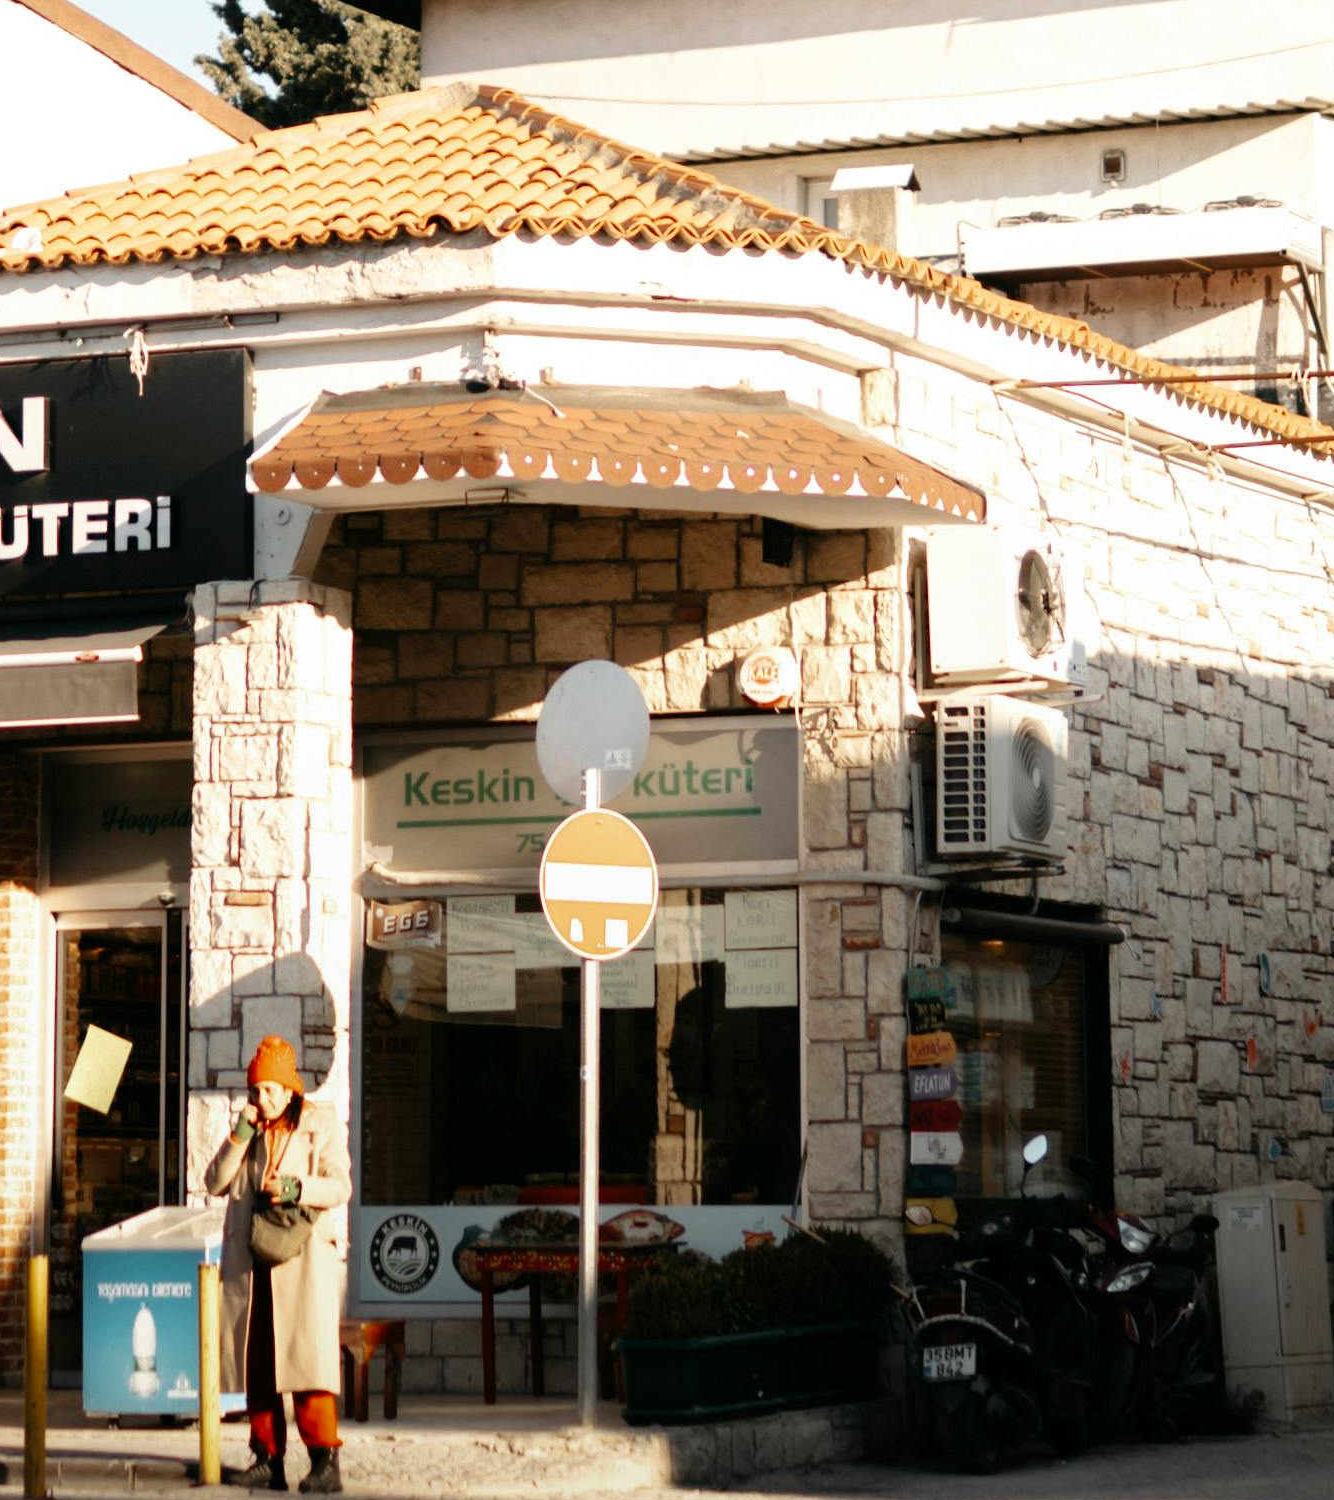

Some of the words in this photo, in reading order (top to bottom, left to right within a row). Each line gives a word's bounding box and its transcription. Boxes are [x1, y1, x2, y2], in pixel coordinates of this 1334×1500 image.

[404, 767, 536, 807] Keskin
[515, 833, 545, 854] 75
[383, 909, 430, 934] EGE
[914, 1072, 952, 1095] EFLATUN
[381, 1215, 428, 1236] KESKİN
